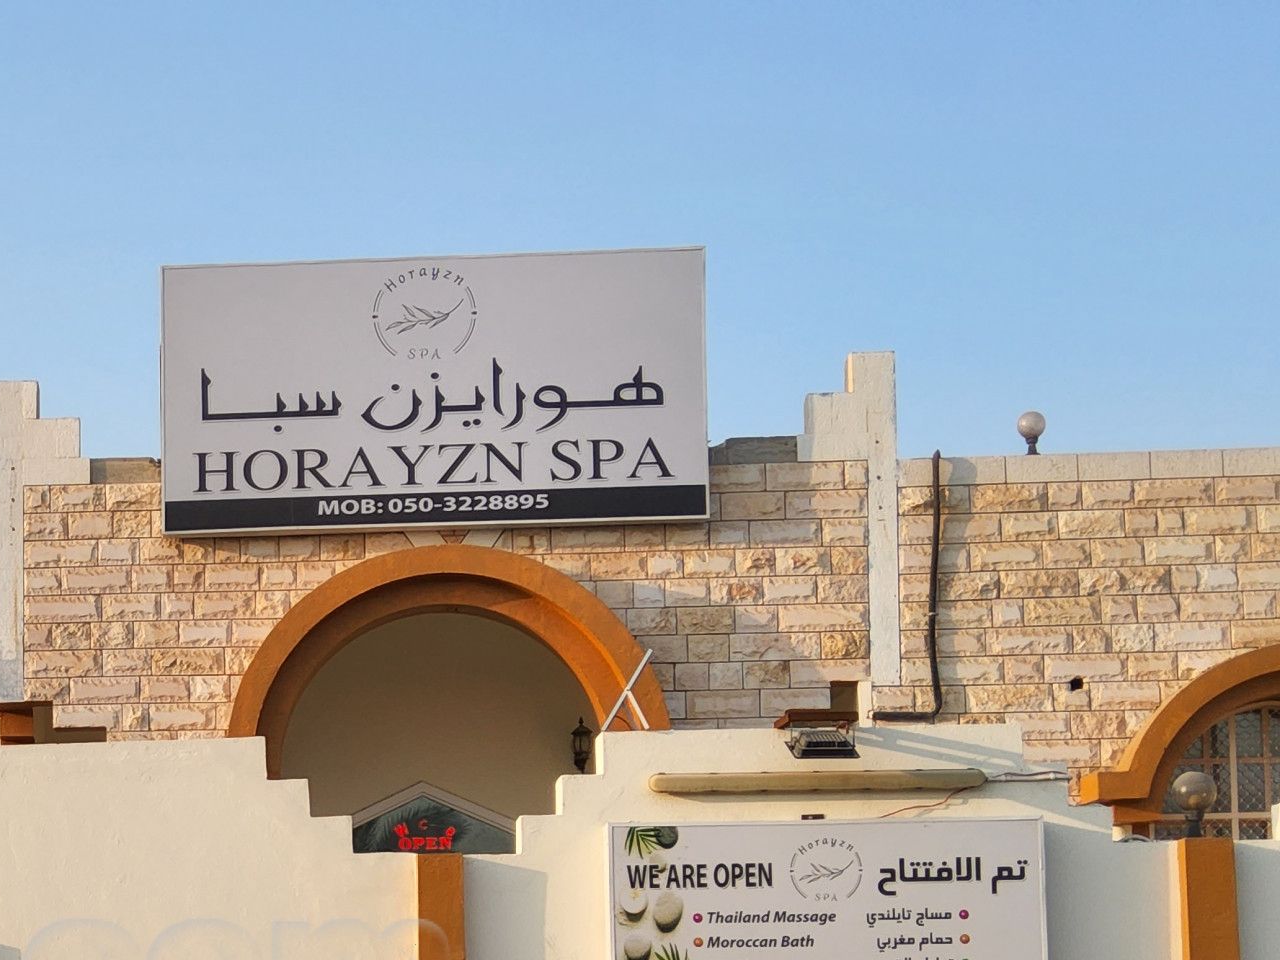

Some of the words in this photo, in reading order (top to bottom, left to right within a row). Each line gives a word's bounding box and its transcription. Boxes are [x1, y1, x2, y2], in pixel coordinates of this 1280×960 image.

[383, 266, 465, 292] Horayzn
[407, 348, 441, 360] SPA
[201, 367, 343, 433] سبا
[361, 357, 664, 433] هورايزن
[192, 441, 529, 493] HORAYZN
[549, 436, 676, 482] SPA
[317, 498, 384, 516] MOB:
[387, 493, 550, 514] 050-3228895
[399, 837, 452, 850] OPEN
[798, 837, 855, 856] Horayzn
[626, 864, 661, 889] WE
[665, 863, 708, 889] ARE
[713, 862, 774, 888] OPEN
[877, 856, 982, 896] الافتتاح
[991, 859, 1029, 895] تم
[814, 892, 838, 902] SPA
[707, 910, 770, 924] Thailand
[773, 910, 837, 926] Massage
[866, 907, 912, 928] تايلندي
[915, 907, 953, 927] مساج
[706, 936, 778, 949] Moroccan
[780, 934, 815, 948] Bath
[876, 934, 916, 953] مغربي
[919, 932, 954, 952] حمام
